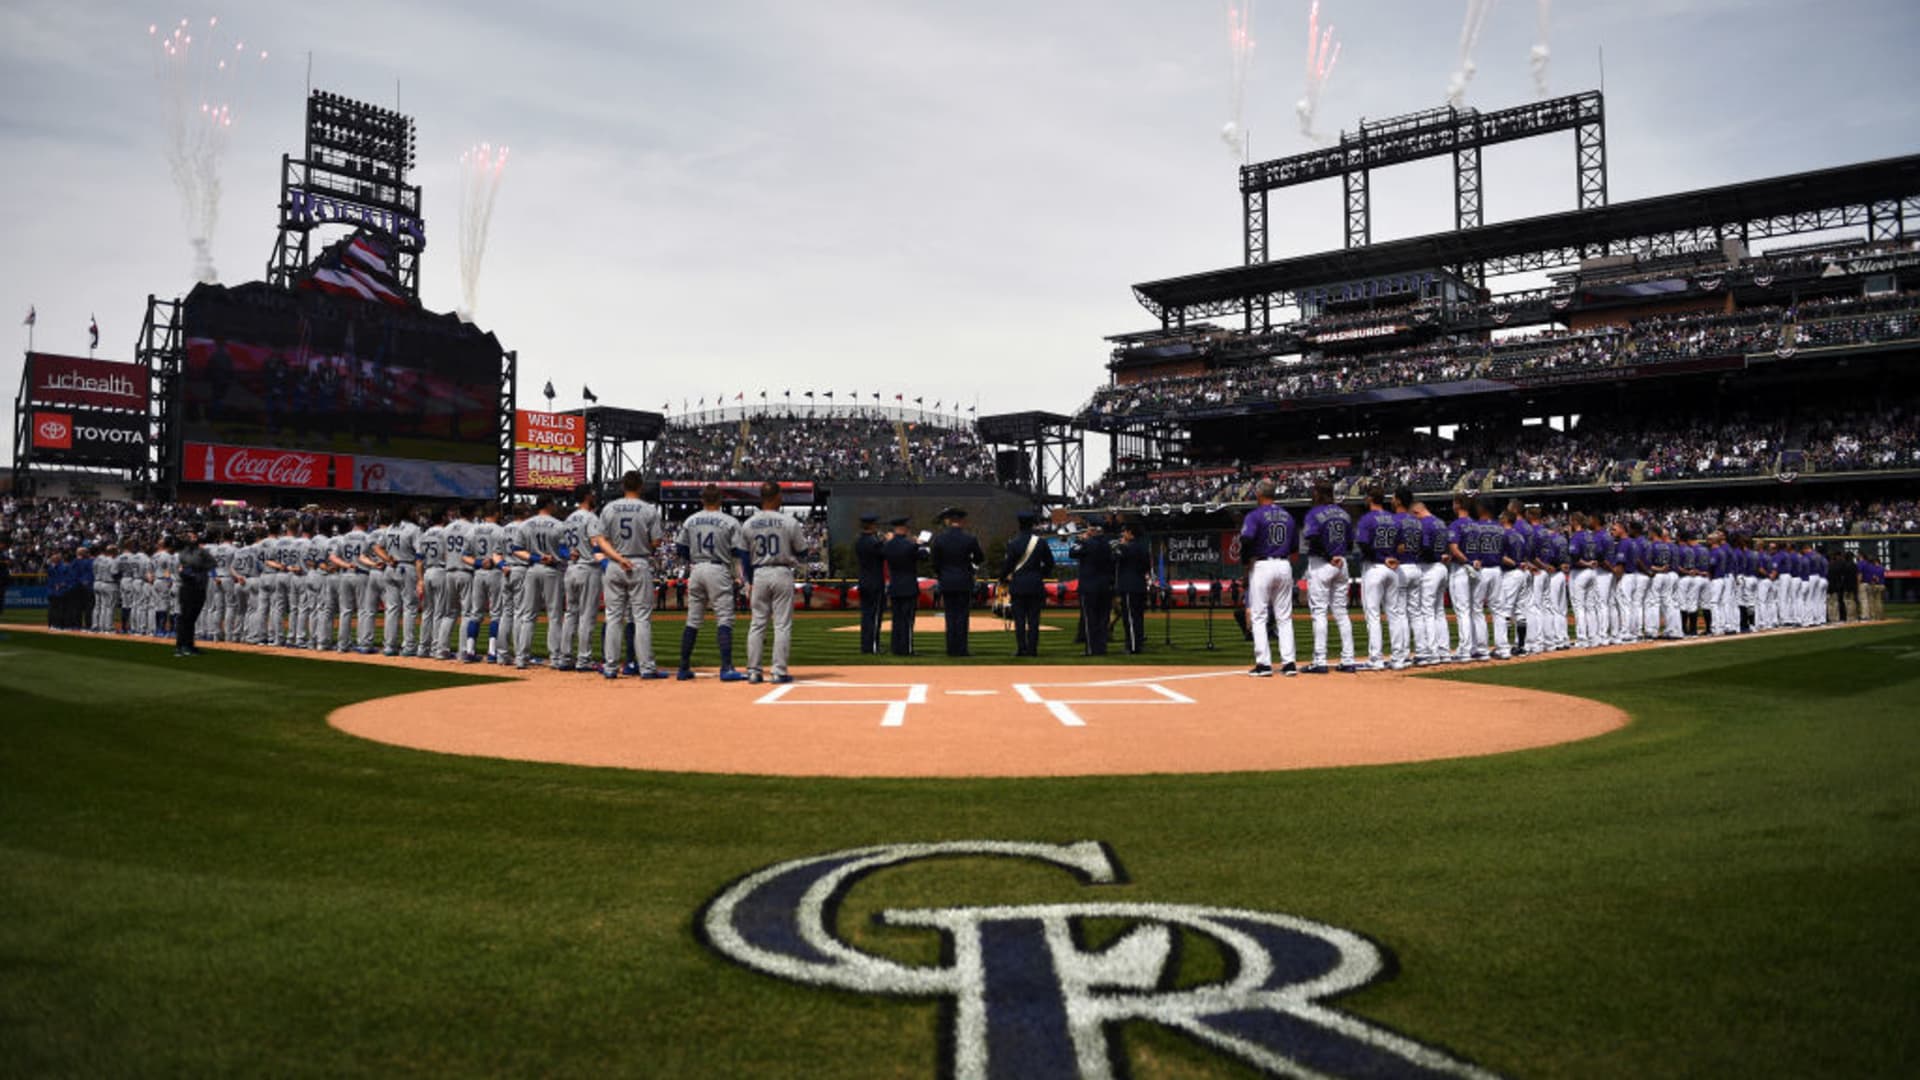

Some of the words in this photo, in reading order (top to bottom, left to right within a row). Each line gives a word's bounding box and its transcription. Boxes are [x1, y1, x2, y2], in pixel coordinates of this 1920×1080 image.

[48, 369, 135, 396] uchealth
[527, 413, 575, 431] WELLS
[75, 426, 144, 444] TOYOTA
[527, 429, 575, 446] FARGO
[528, 453, 574, 475] KING
[564, 527, 580, 548] 35
[620, 517, 633, 540] 5
[1268, 522, 1287, 546] 10
[388, 534, 401, 551] 74
[422, 541, 438, 558] 75
[447, 535, 464, 553] 99
[479, 538, 488, 556] 3
[536, 532, 547, 553] 11
[697, 531, 715, 555] 14
[755, 533, 780, 557] 30
[1168, 537, 1195, 549] Bank
[1197, 535, 1209, 548] of
[344, 544, 361, 560] 64
[1169, 547, 1219, 561] Colorado
